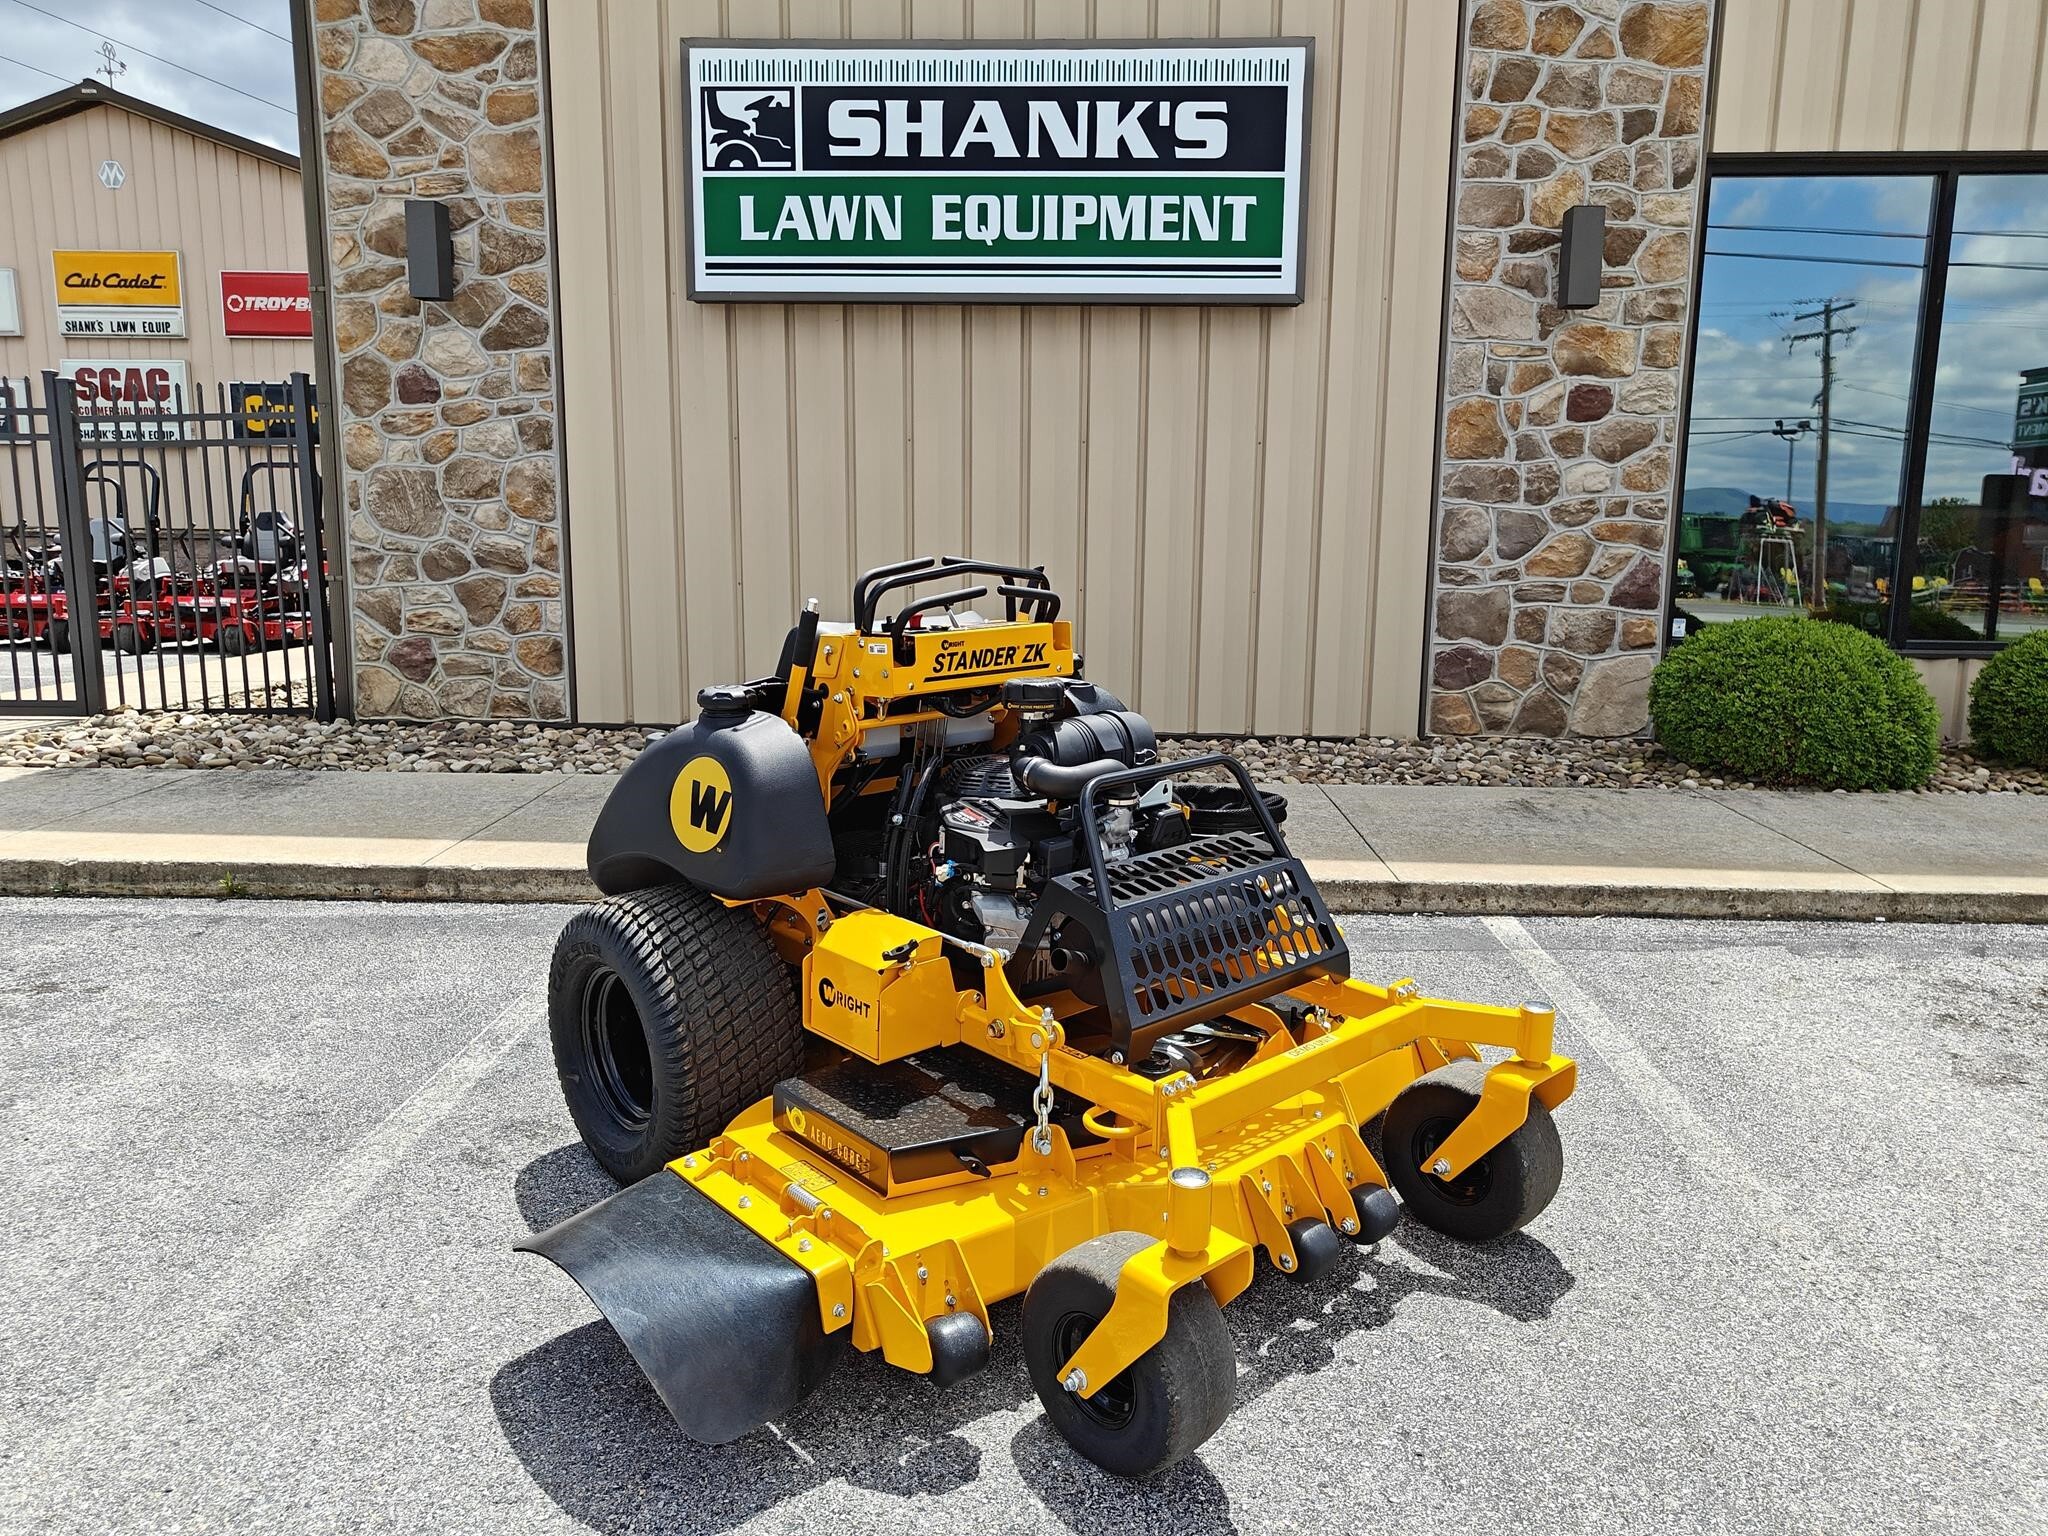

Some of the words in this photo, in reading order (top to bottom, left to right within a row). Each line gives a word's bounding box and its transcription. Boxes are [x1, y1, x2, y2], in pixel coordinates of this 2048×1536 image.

[828, 98, 1229, 160] SHANK'S
[738, 194, 903, 242] LAWN
[931, 194, 1257, 247] EQUIPMENT
[64, 272, 101, 288] Cub
[102, 272, 166, 289] Cadet
[65, 320, 104, 333] SHANK'S
[110, 321, 137, 333] LAWN
[142, 321, 171, 333] EQUIP
[75, 367, 171, 402] SCAG
[932, 646, 1017, 674] STANDER
[1021, 642, 1047, 664] ZK
[690, 779, 732, 835] W
[818, 977, 871, 1019] WRIGHT
[810, 1124, 833, 1150] AERO
[837, 1142, 861, 1169] CORE
